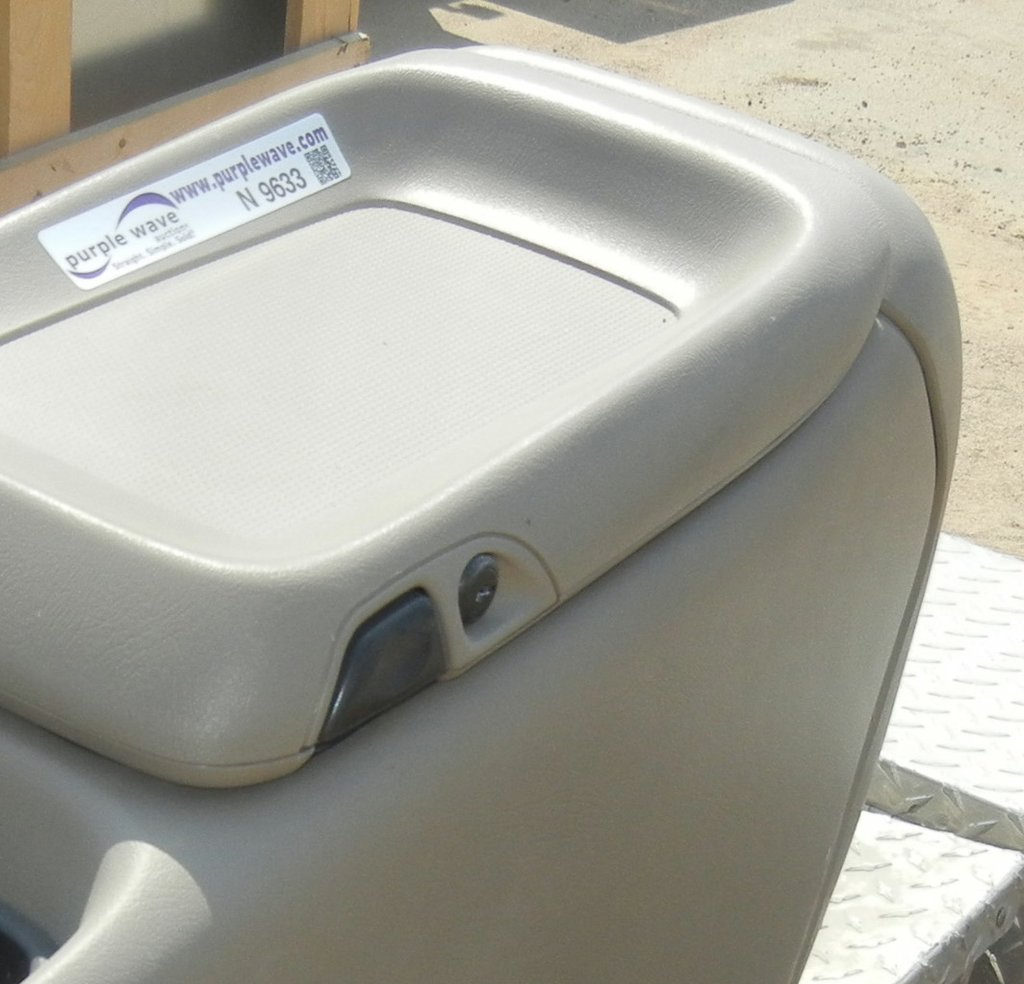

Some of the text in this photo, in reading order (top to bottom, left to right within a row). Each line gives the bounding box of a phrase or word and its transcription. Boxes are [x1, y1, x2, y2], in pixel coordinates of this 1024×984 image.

[169, 126, 329, 205] www.purplewave.com
[236, 168, 307, 211] N 9633
[66, 211, 179, 270] purple wave
